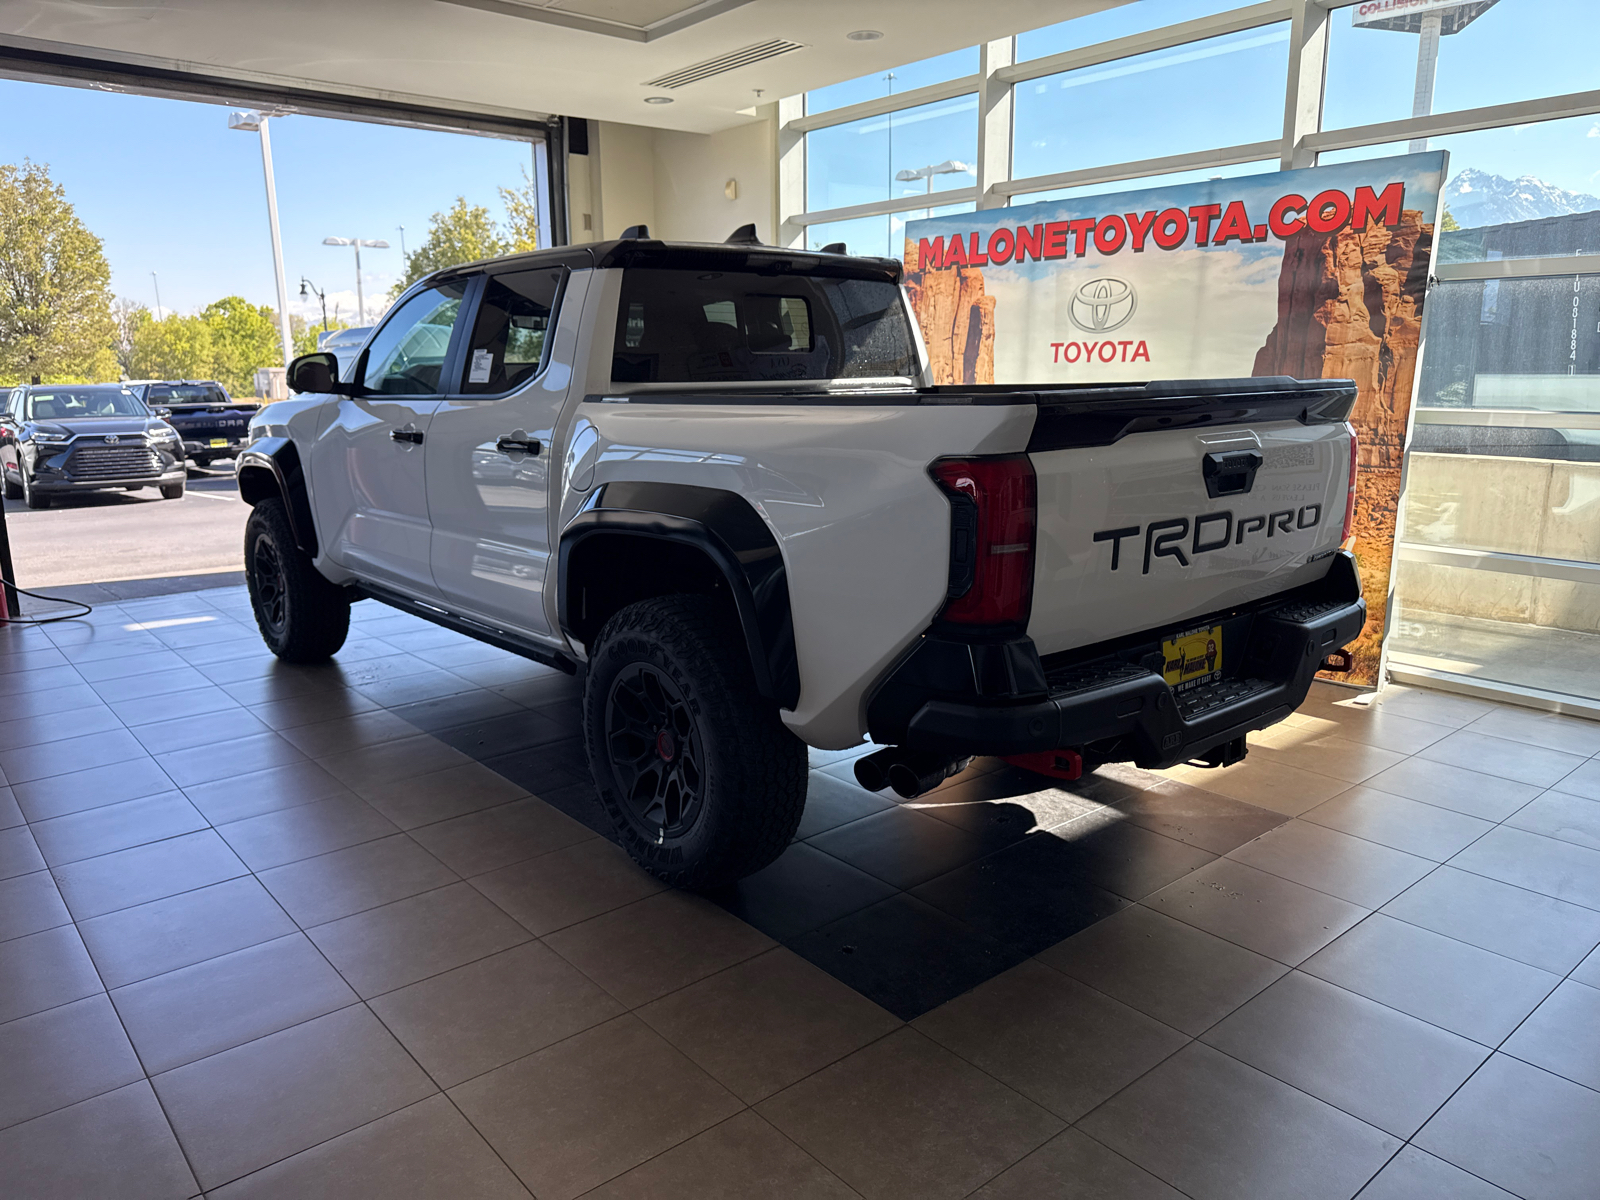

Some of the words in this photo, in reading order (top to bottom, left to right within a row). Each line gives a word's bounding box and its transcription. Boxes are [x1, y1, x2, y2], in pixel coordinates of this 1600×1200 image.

[918, 181, 1405, 273] MALONETOYOTA.COM
[1050, 340, 1151, 364] TOYOTA
[1093, 510, 1233, 575] TRD
[1235, 502, 1322, 545] PRO
[1208, 643, 1215, 653] 32
[608, 637, 701, 718] GOODYEAR
[1165, 659, 1181, 673] KARL
[1183, 659, 1206, 675] MALONE
[1177, 683, 1185, 692] WE
[1185, 679, 1196, 689] MAKE
[1201, 674, 1212, 684] EASY
[1165, 733, 1181, 747] ARB
[601, 787, 683, 866] WRANGLER
